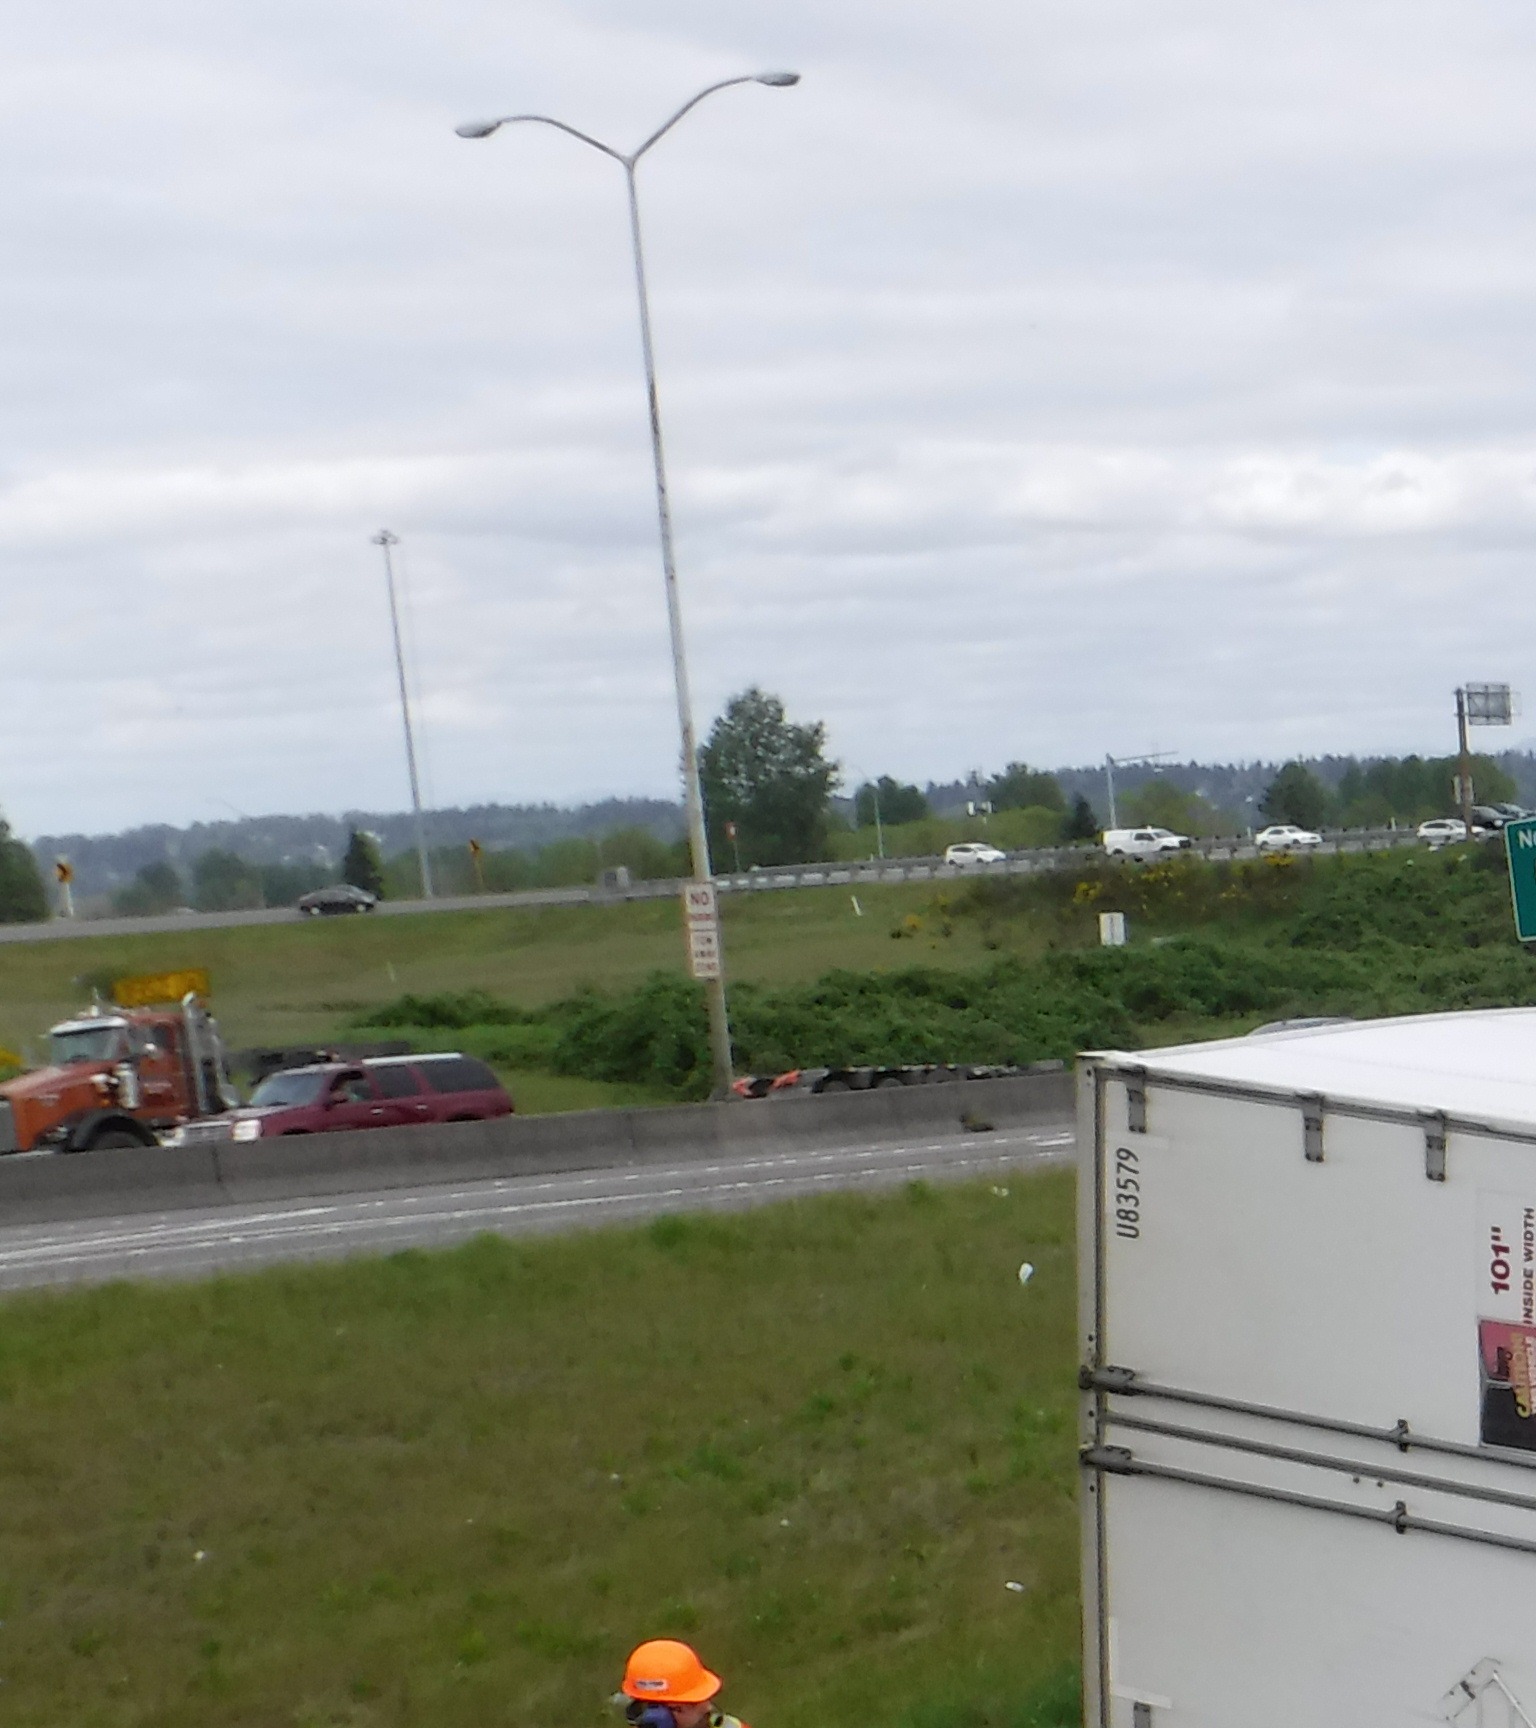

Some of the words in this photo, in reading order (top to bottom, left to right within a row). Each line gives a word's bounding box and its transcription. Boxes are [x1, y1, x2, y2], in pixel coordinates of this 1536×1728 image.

[1116, 1147, 1140, 1239] U83579
[1491, 1226, 1511, 1296] 101"
[1523, 1207, 1536, 1263] WIDTH
[1522, 1268, 1535, 1325] INSIDE
